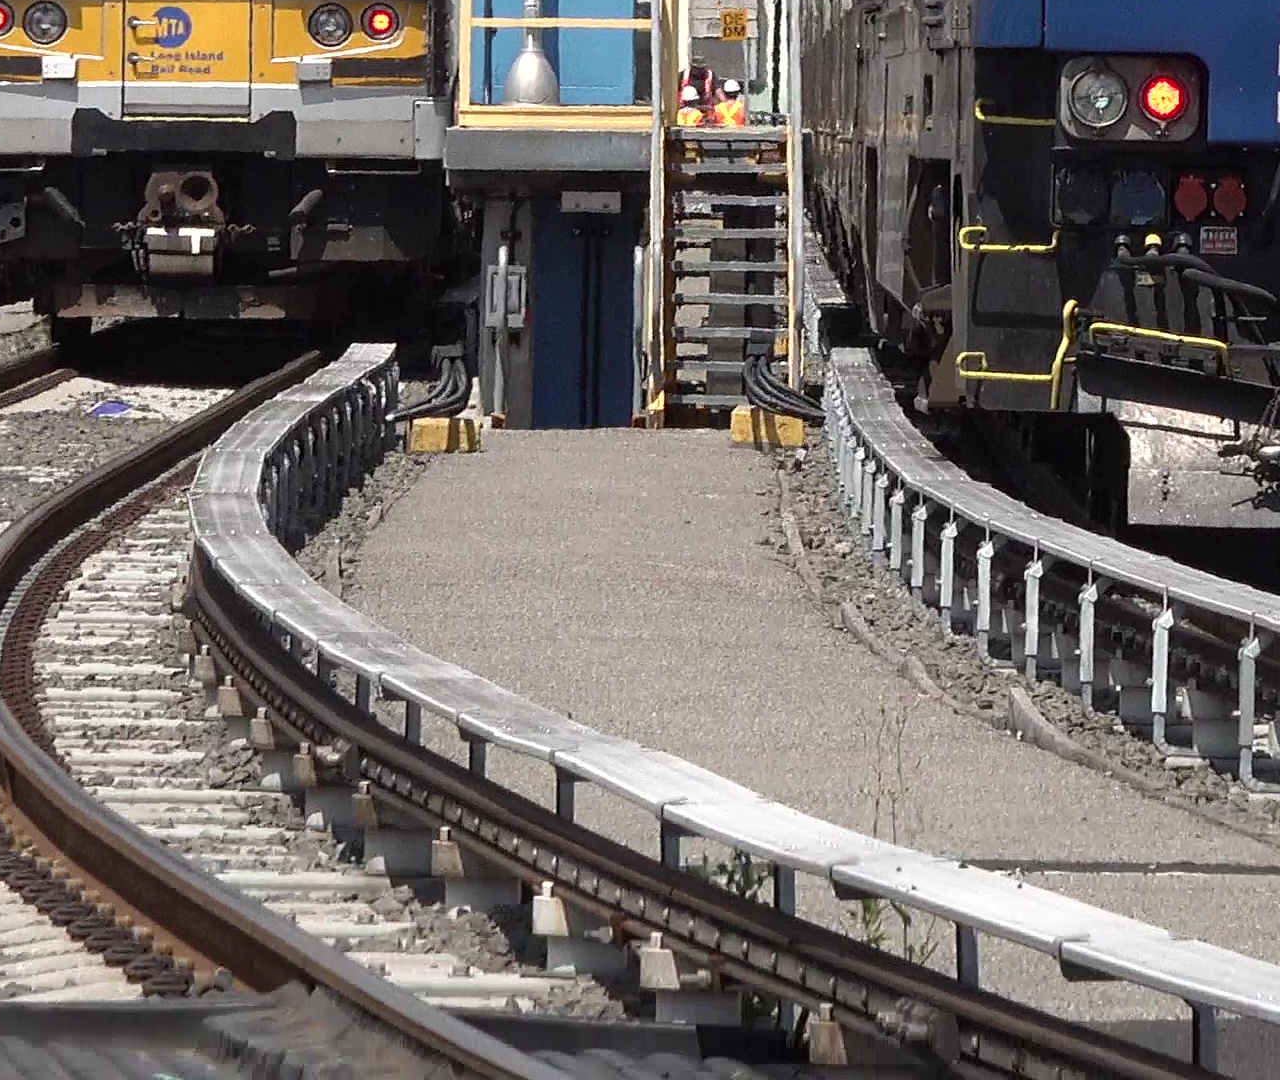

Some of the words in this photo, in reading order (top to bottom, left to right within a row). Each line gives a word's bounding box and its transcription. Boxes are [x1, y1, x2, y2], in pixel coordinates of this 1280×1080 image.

[154, 16, 186, 38] MTA
[185, 50, 224, 61] Island
[151, 64, 175, 75] Rail
[179, 64, 211, 75] Road
